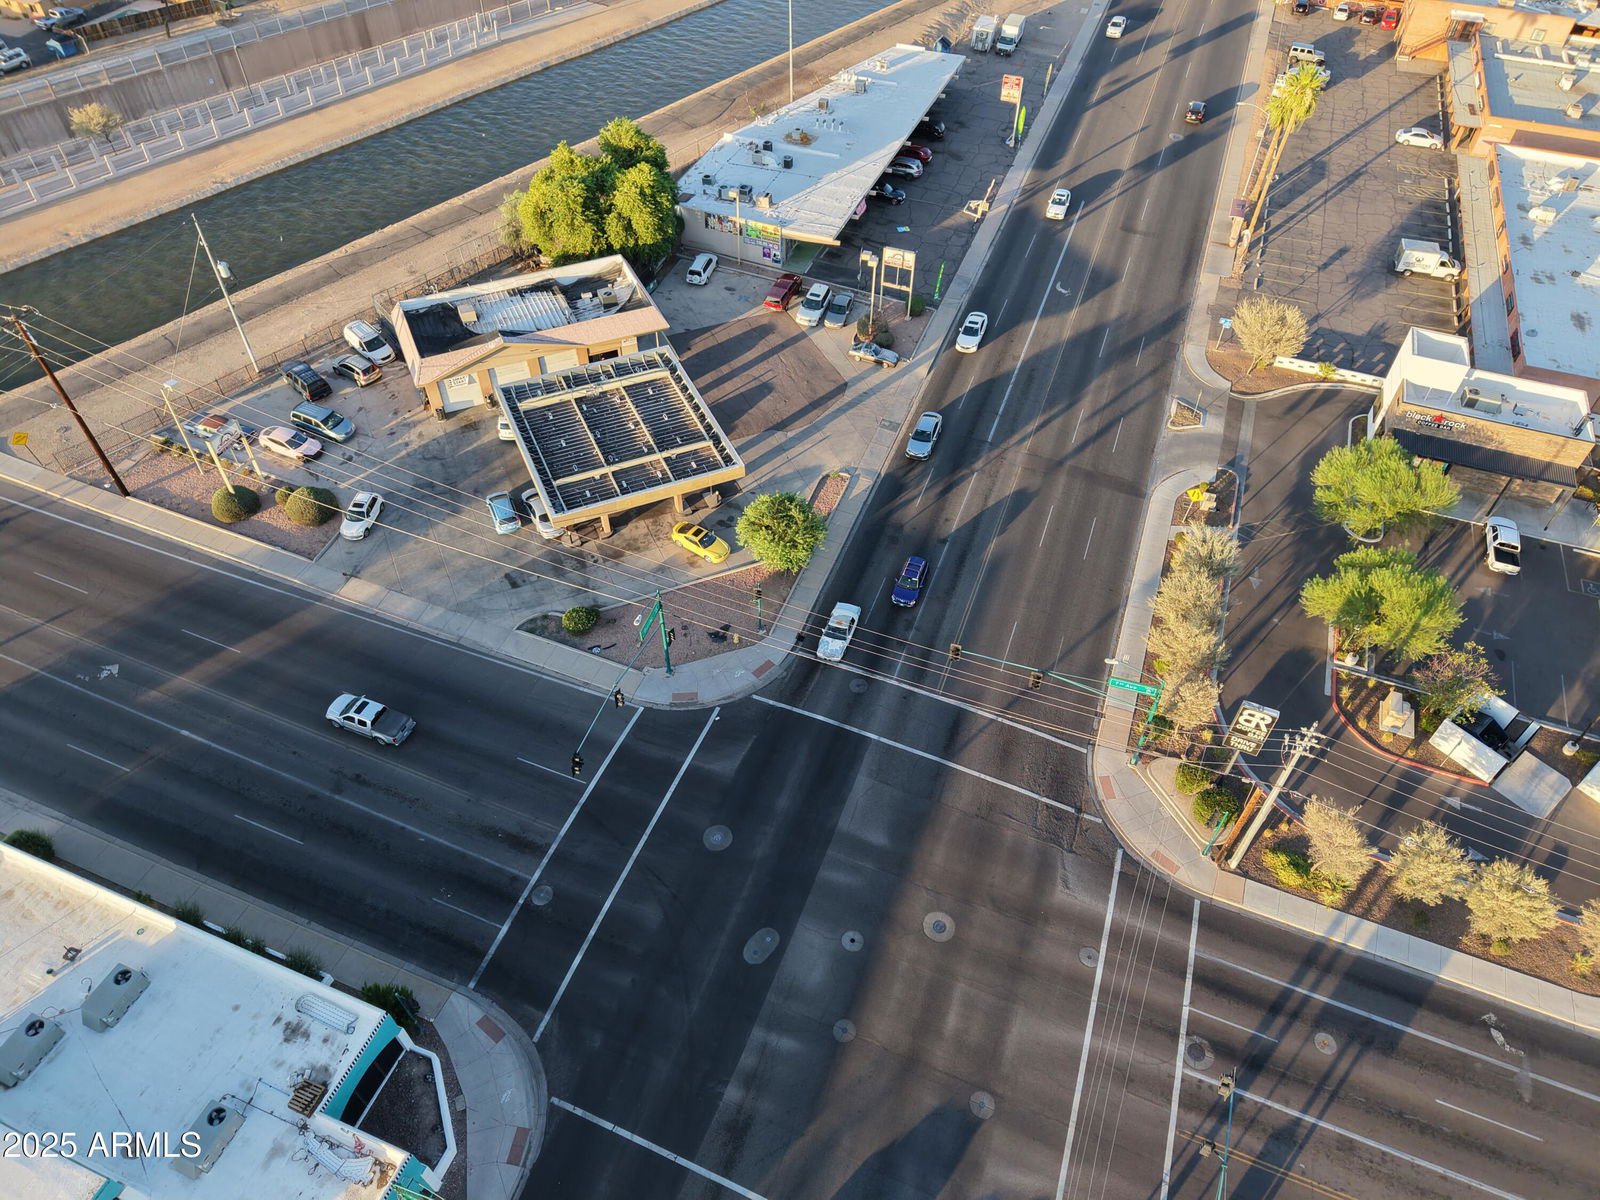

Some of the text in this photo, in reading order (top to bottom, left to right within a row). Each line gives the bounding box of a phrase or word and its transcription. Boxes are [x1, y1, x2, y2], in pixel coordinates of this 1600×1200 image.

[1405, 411, 1467, 430] black rock
[1230, 735, 1258, 748] DRIVE
[1230, 741, 1254, 752] THRU
